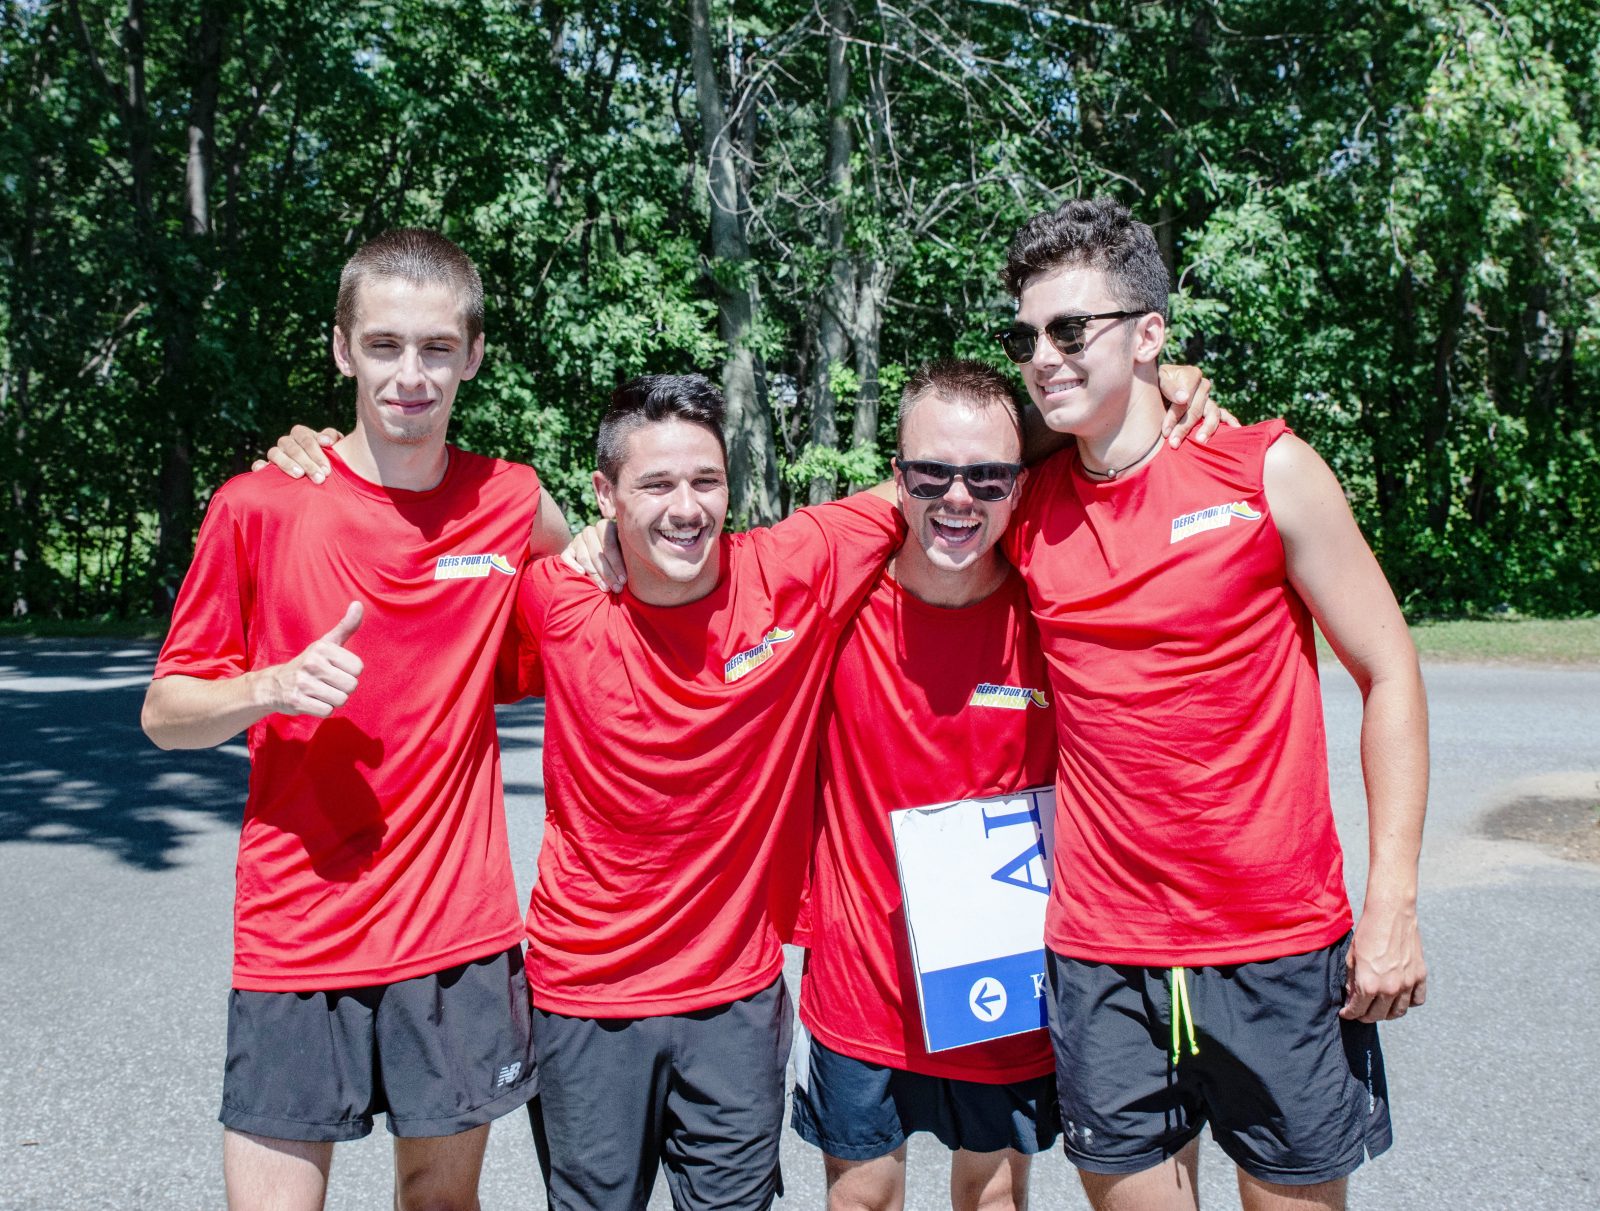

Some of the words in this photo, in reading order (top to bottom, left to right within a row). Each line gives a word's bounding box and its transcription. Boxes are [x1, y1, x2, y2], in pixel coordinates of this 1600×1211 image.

[1197, 507, 1219, 521] POUR
[1221, 505, 1231, 514] LA
[461, 556, 482, 565] POUR
[482, 555, 491, 564] LA
[744, 644, 764, 660] POUR
[999, 686, 1021, 697] POUR
[1021, 688, 1032, 698] LA
